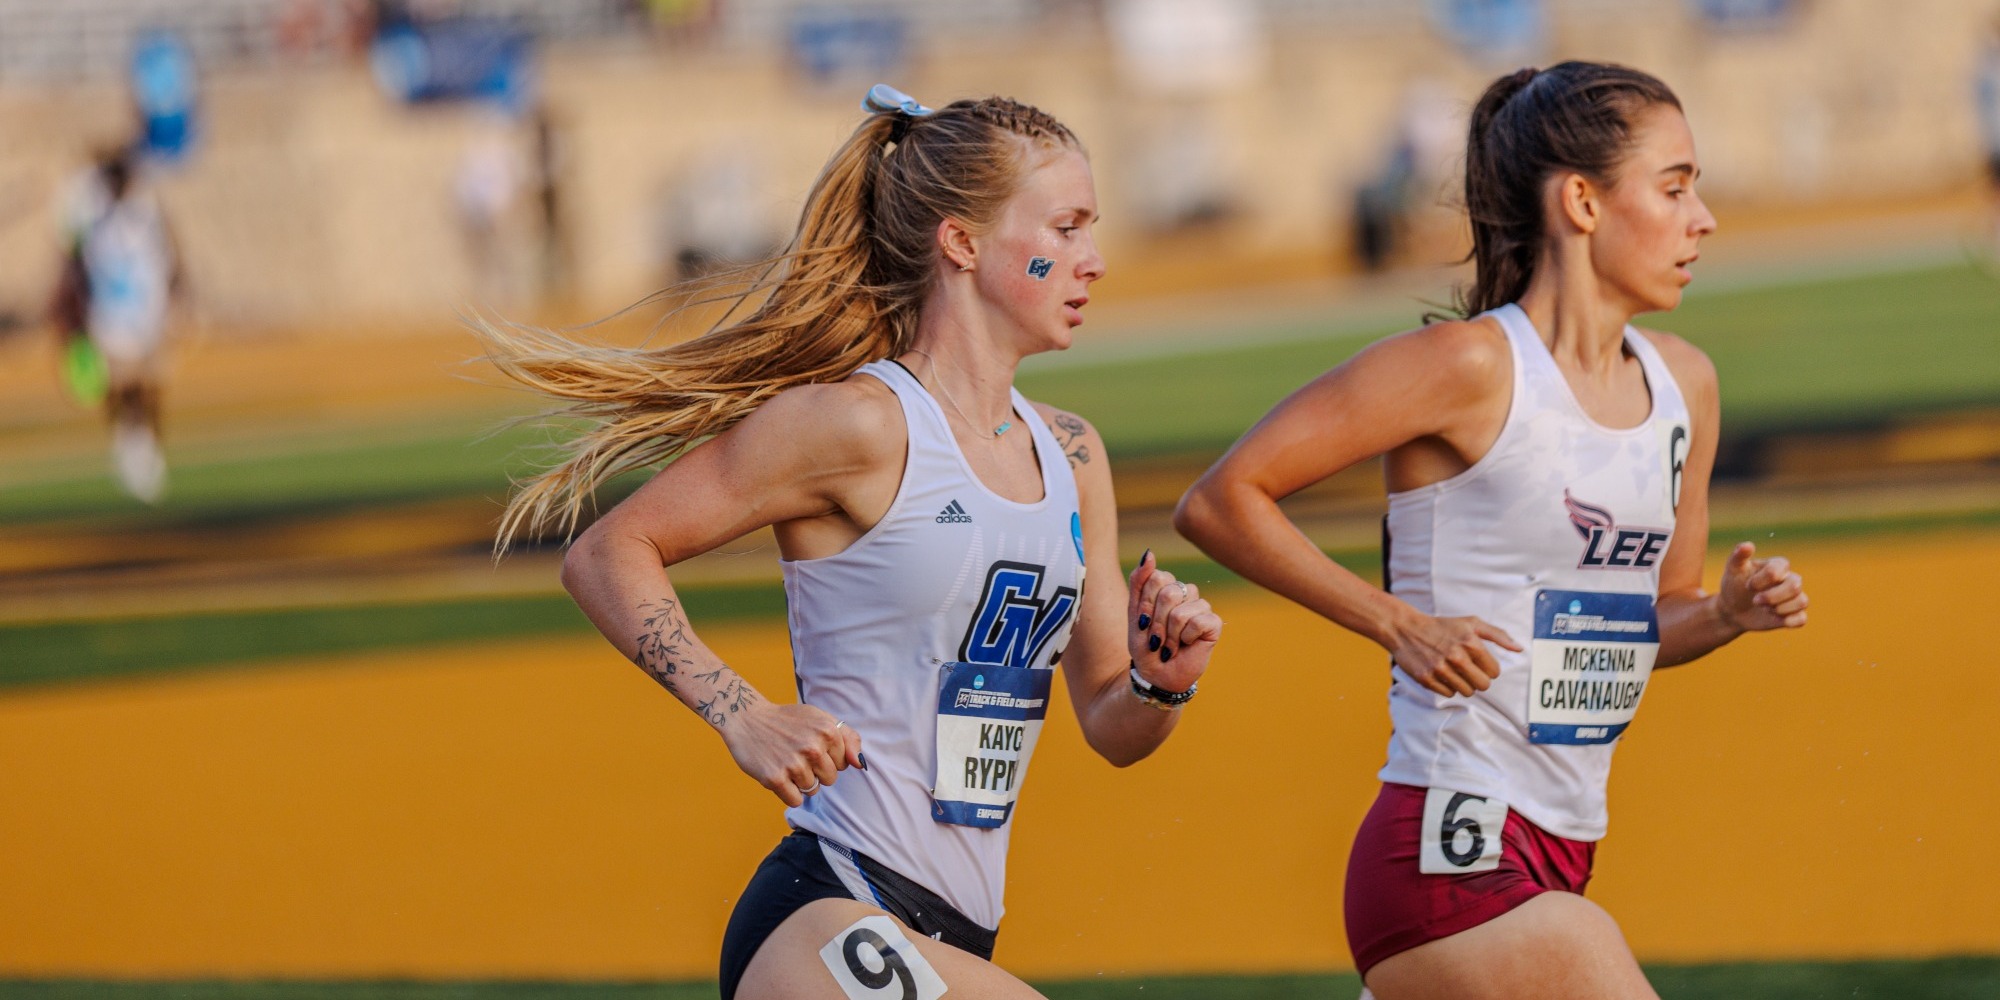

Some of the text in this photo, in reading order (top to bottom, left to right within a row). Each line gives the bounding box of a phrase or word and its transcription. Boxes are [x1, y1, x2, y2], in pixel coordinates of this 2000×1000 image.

[936, 514, 972, 523] adidas
[1577, 526, 1672, 571] LEE
[1563, 647, 1635, 672] MCKENNA
[970, 694, 989, 706] TRACK
[996, 697, 1015, 707] FIELD
[1541, 680, 1644, 709] CAVANAUGH
[1441, 791, 1487, 867] 6
[843, 928, 917, 1000] 9
